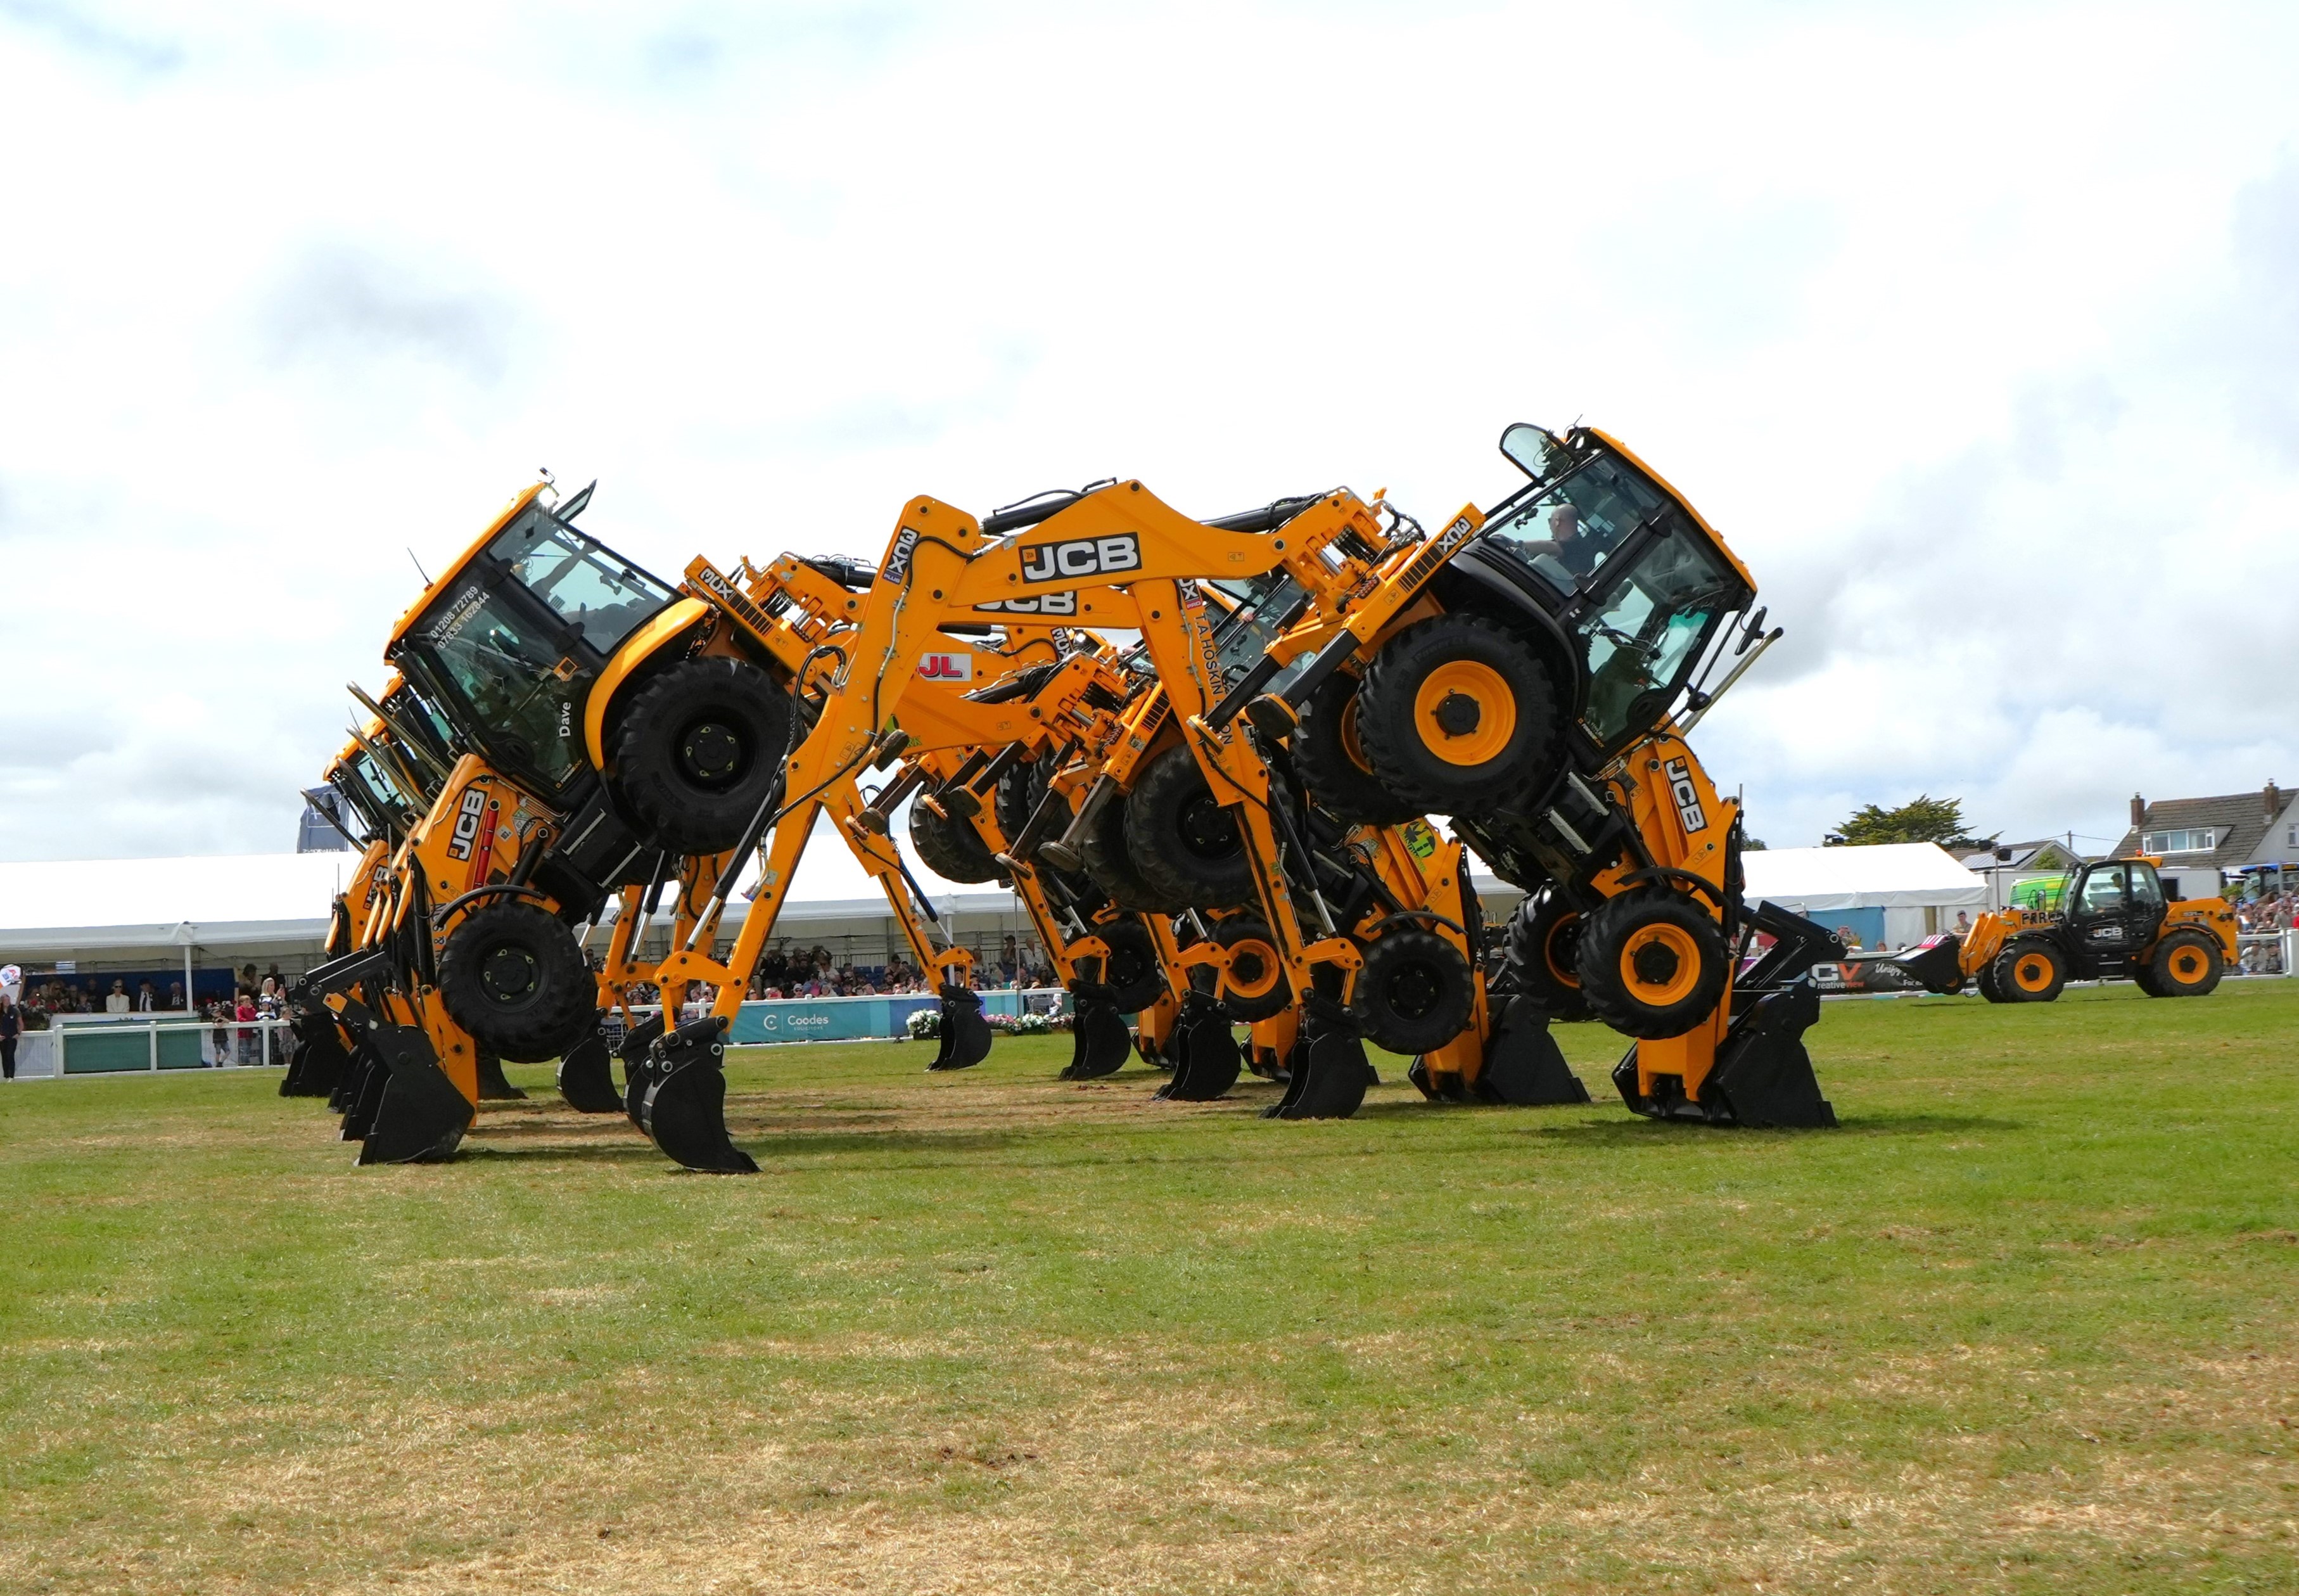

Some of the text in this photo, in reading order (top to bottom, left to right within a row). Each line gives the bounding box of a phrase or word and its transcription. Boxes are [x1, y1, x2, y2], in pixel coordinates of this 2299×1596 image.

[1024, 537, 1138, 580] JCB
[884, 573, 900, 583] PLUS
[431, 586, 478, 638] 01208 72789
[438, 591, 490, 649] 07833 162844
[919, 656, 962, 677] JL
[559, 702, 571, 737] Dave
[1665, 760, 1705, 831] JCB
[451, 790, 485, 860] JCB
[2093, 927, 2123, 938] JCB
[1811, 962, 1862, 981] CV
[787, 1014, 829, 1026] Coodes
